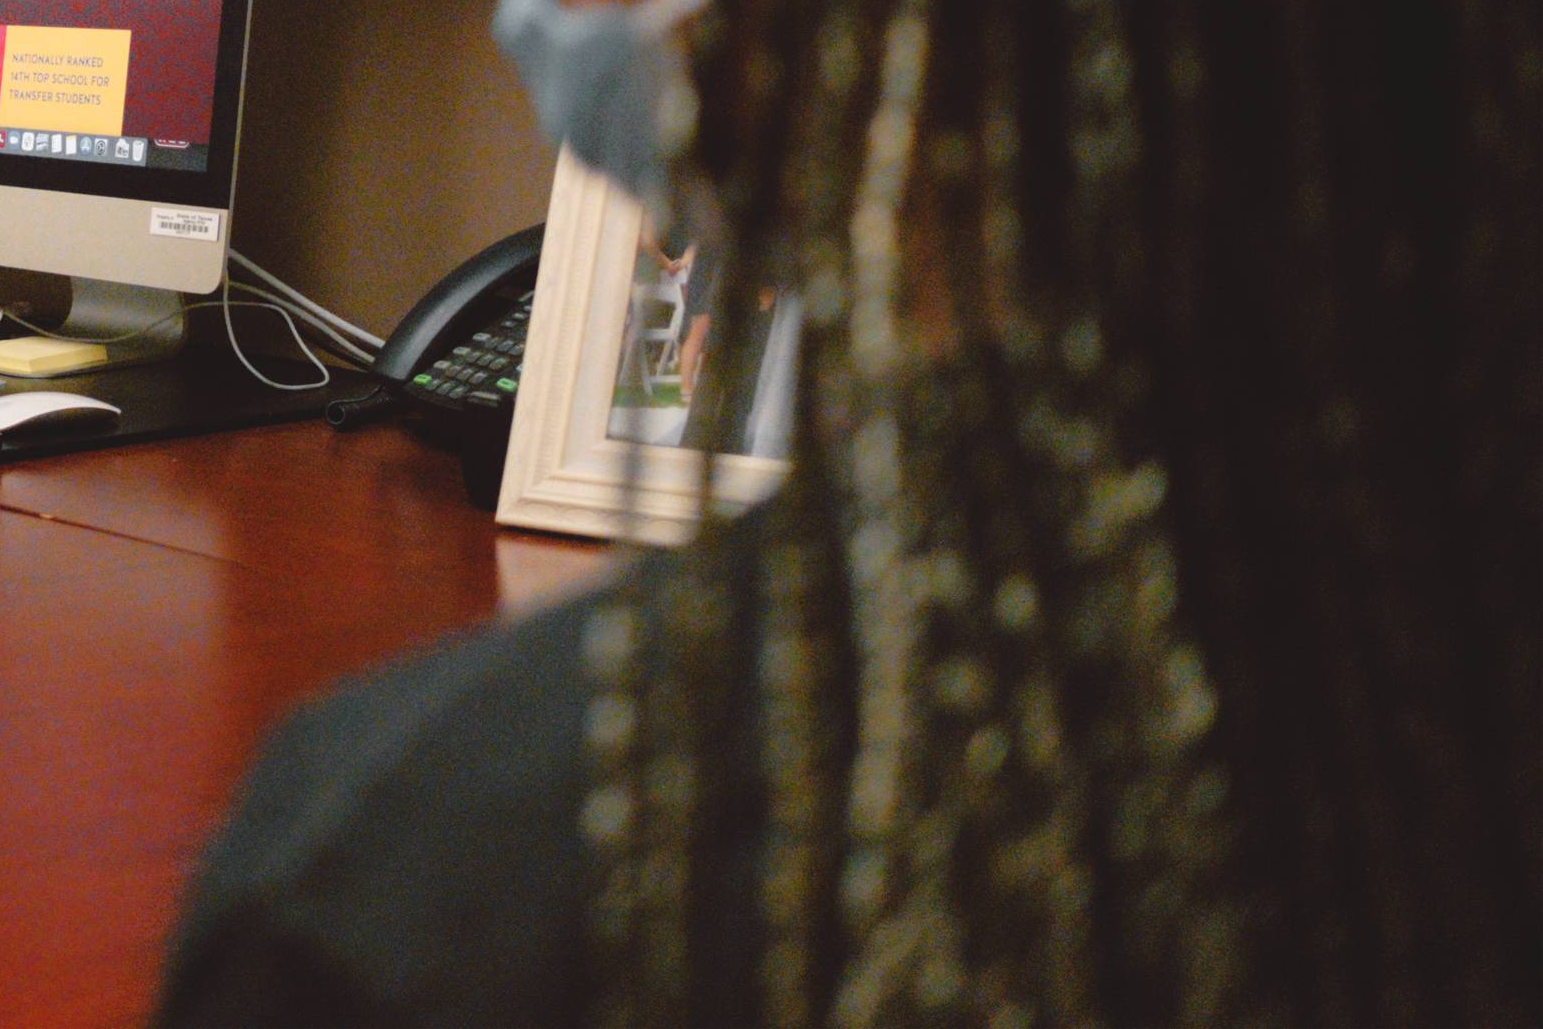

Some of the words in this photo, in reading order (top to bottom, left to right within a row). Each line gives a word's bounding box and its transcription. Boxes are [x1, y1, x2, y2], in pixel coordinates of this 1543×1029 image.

[12, 53, 64, 66] NATIONALLY
[66, 56, 104, 68] RANKED
[11, 71, 30, 82] 14TH
[32, 72, 50, 83] TOP
[51, 74, 88, 86] SCHOOL
[91, 75, 110, 87] FOR
[8, 89, 53, 102] TRANSFER
[55, 92, 102, 106] STUDENTS
